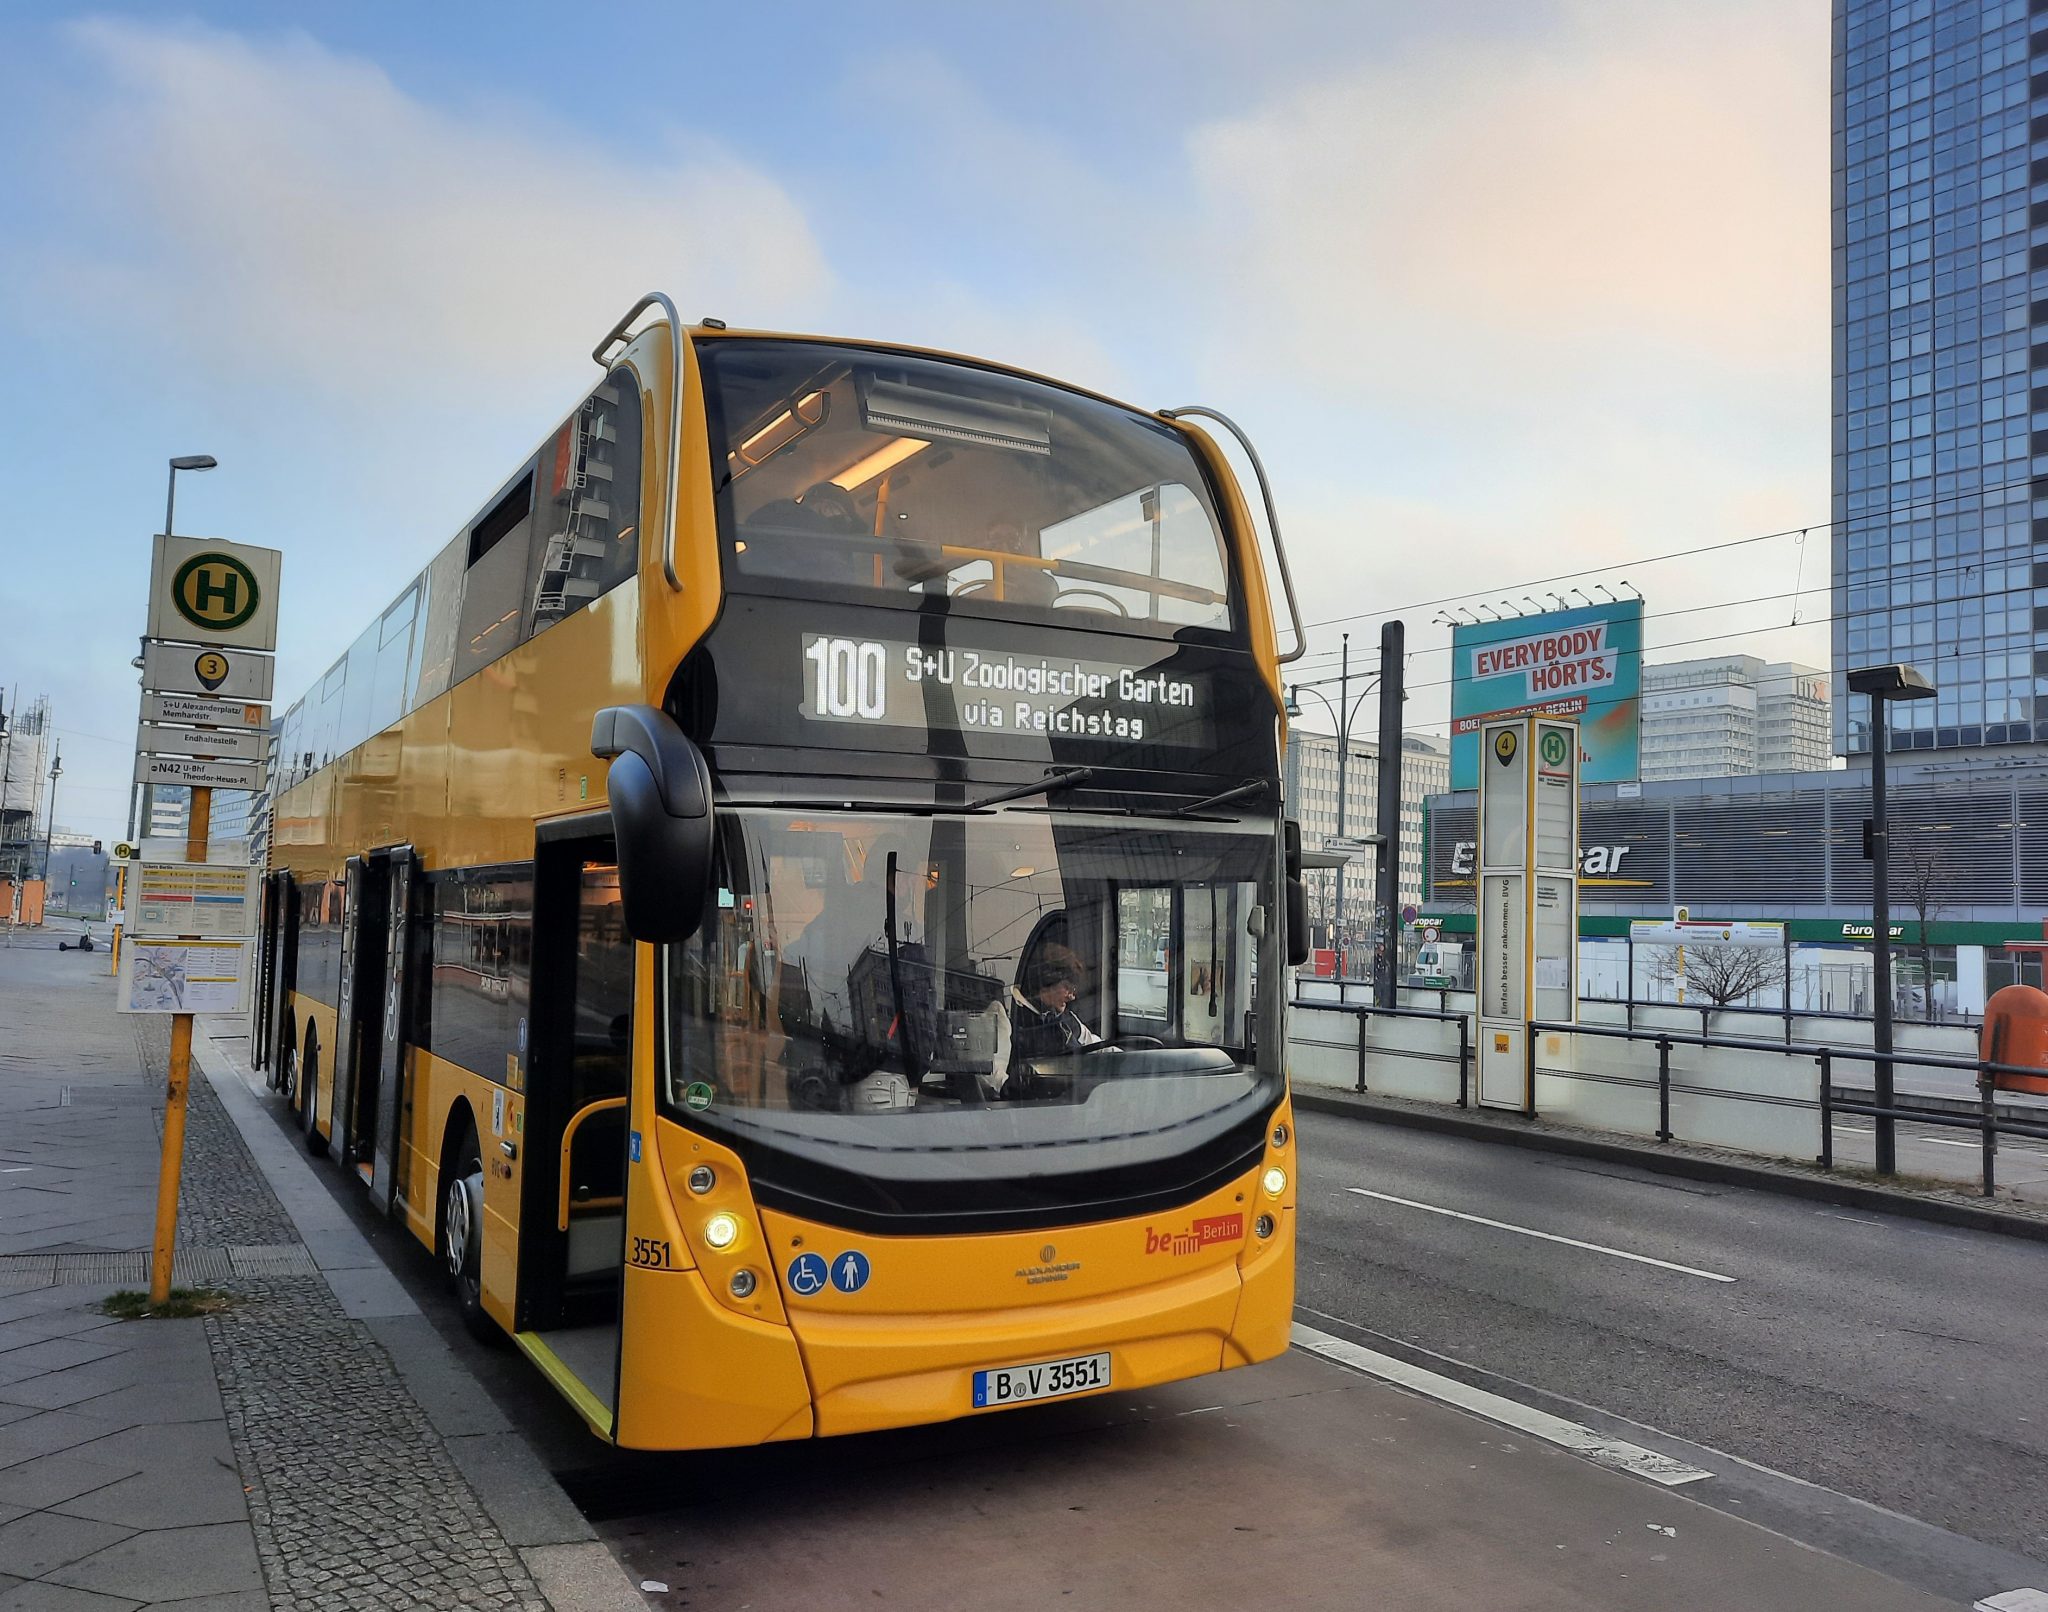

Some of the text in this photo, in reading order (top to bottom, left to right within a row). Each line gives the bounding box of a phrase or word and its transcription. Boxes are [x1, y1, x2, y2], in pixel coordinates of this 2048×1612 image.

[196, 569, 238, 615] H
[1477, 627, 1603, 675] EVERYBODY
[206, 659, 218, 675] 3
[1532, 656, 1613, 692] HÖRTS.
[806, 637, 887, 719] 100
[905, 647, 1195, 707] S+U Zoologischer Garten
[163, 700, 180, 709] S+U
[1546, 699, 1582, 715] BERLIN
[162, 709, 212, 721] Memhardstr.
[246, 708, 260, 727] A
[964, 698, 1145, 741] via Reichstag
[184, 733, 238, 746] Endhaltestelle
[1501, 738, 1509, 751] 4
[1547, 739, 1560, 759] H
[158, 763, 206, 774] N42 U-Bhf
[182, 772, 249, 785] Theodor-Heuss-Pl.
[1405, 917, 1444, 927] ropcar
[1841, 923, 1904, 938] Euroar
[1500, 982, 1508, 1015] Einfach
[1202, 1221, 1239, 1241] Berlin
[631, 1236, 671, 1268] 3551
[996, 1373, 1012, 1400] B
[1028, 1367, 1043, 1395] V
[1048, 1358, 1101, 1393] 3551
